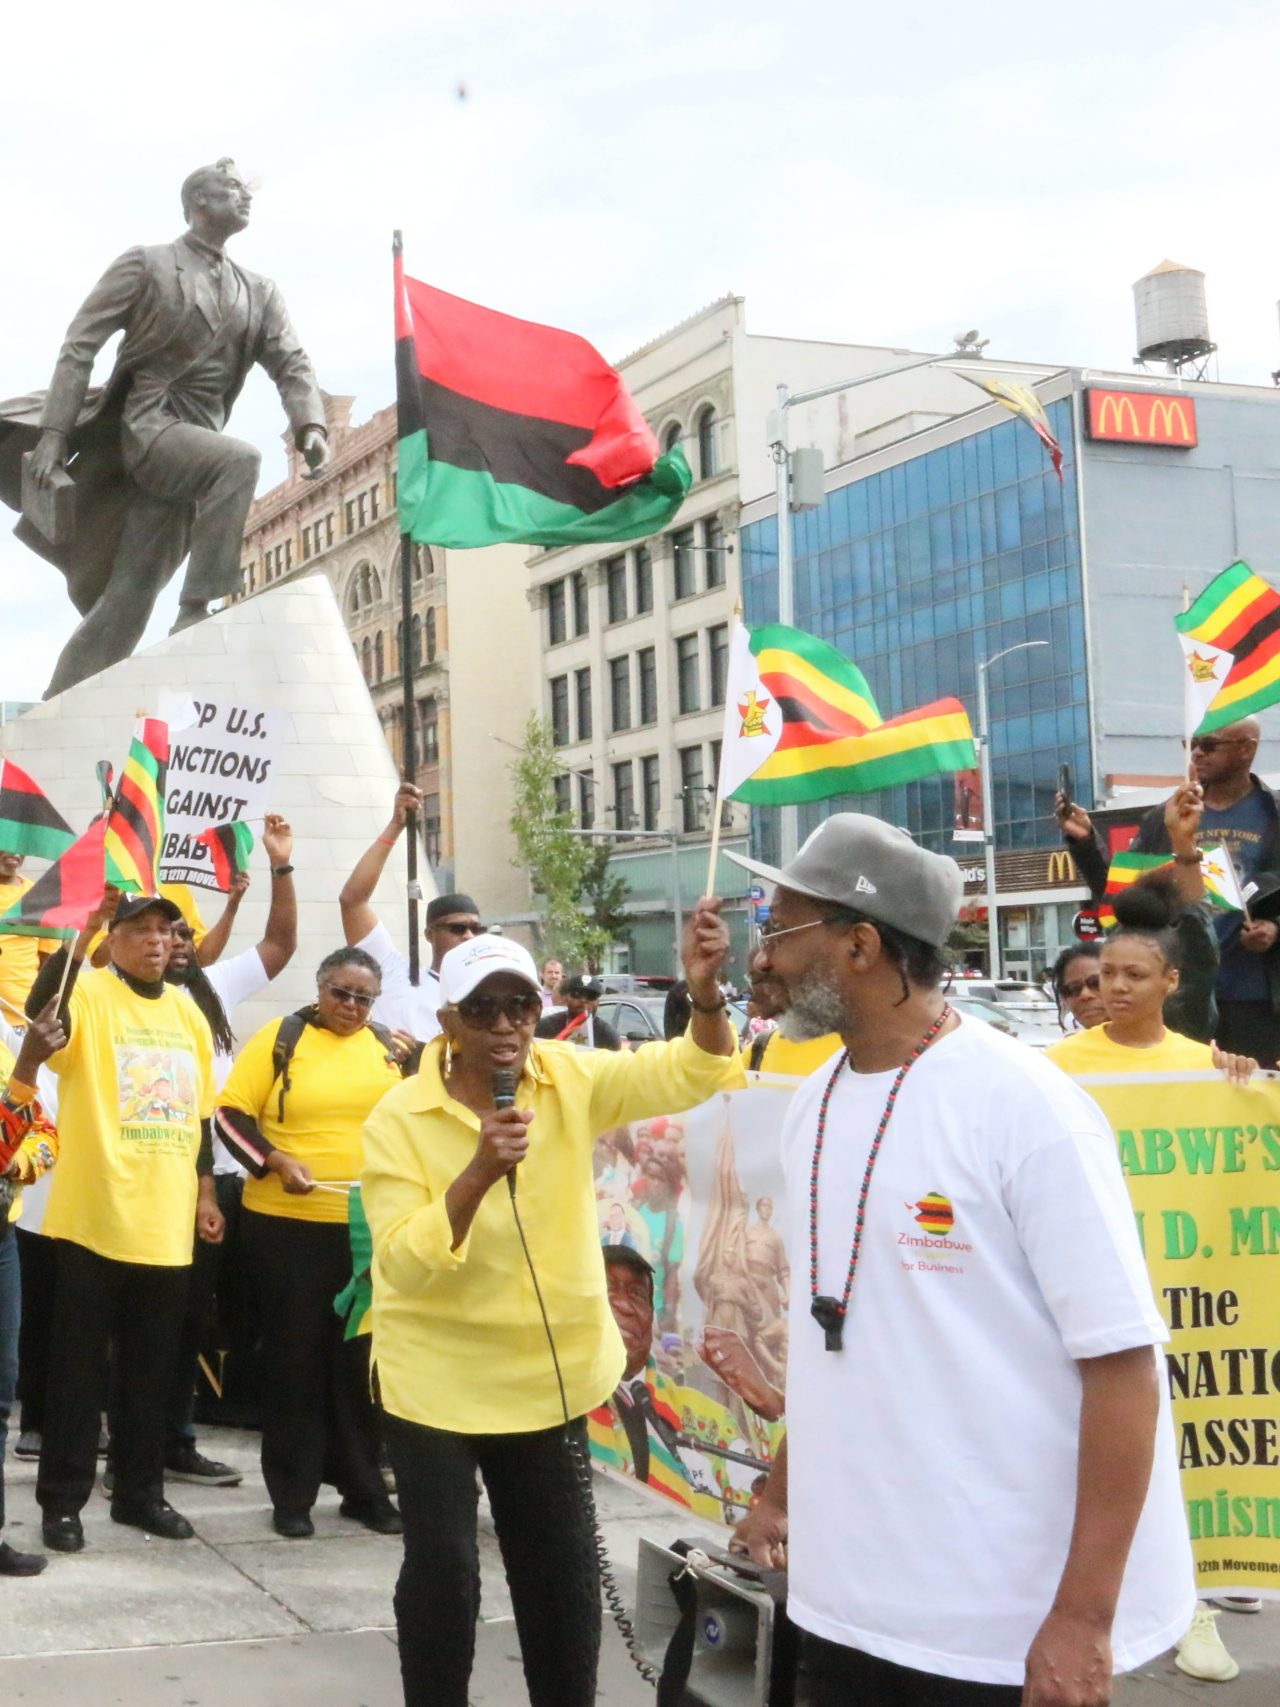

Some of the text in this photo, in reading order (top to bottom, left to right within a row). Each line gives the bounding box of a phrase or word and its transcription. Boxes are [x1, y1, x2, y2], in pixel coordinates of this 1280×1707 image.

[225, 706, 267, 739] U.S.
[166, 743, 272, 785] NCTIONS
[897, 1231, 973, 1253] Zimbabwe
[1161, 1210, 1214, 1260] D.
[918, 1260, 964, 1275] Business
[1162, 1286, 1239, 1330] The
[1197, 1559, 1280, 1573] 12th Moveme
